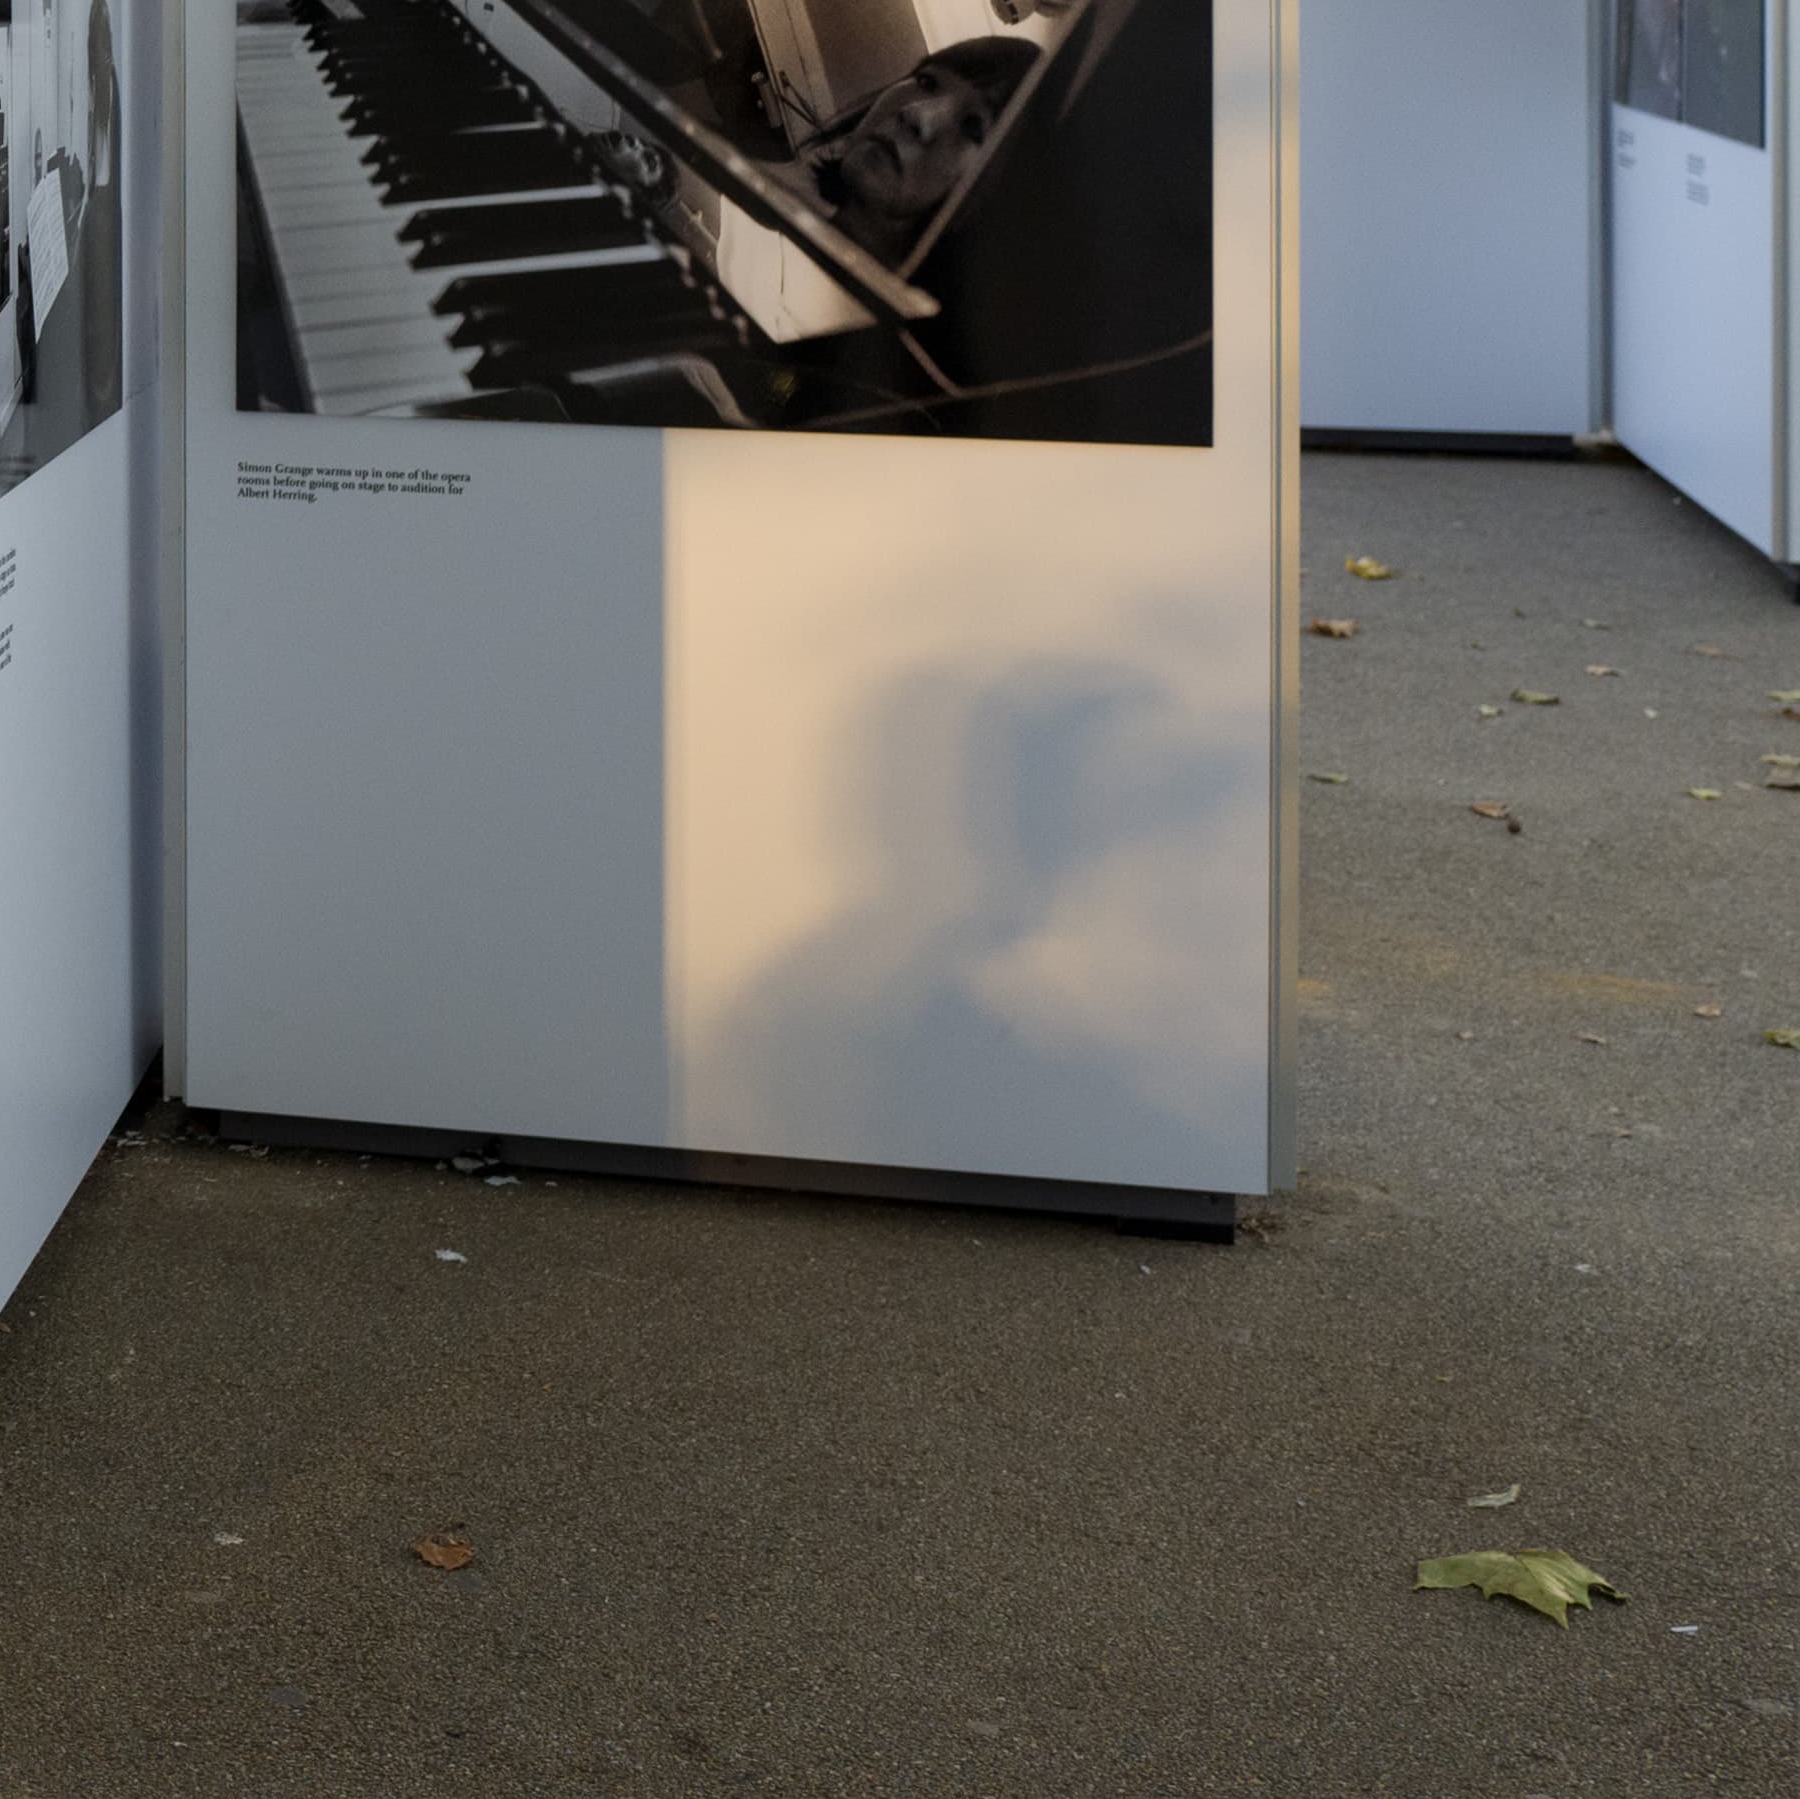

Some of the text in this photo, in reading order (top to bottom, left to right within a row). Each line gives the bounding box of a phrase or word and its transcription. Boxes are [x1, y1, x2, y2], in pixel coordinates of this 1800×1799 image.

[238, 462, 470, 485] Simon Grange warms up in one of the opera
[238, 477, 463, 495] rooms before going on stage to audition for
[238, 487, 269, 498] Albert
